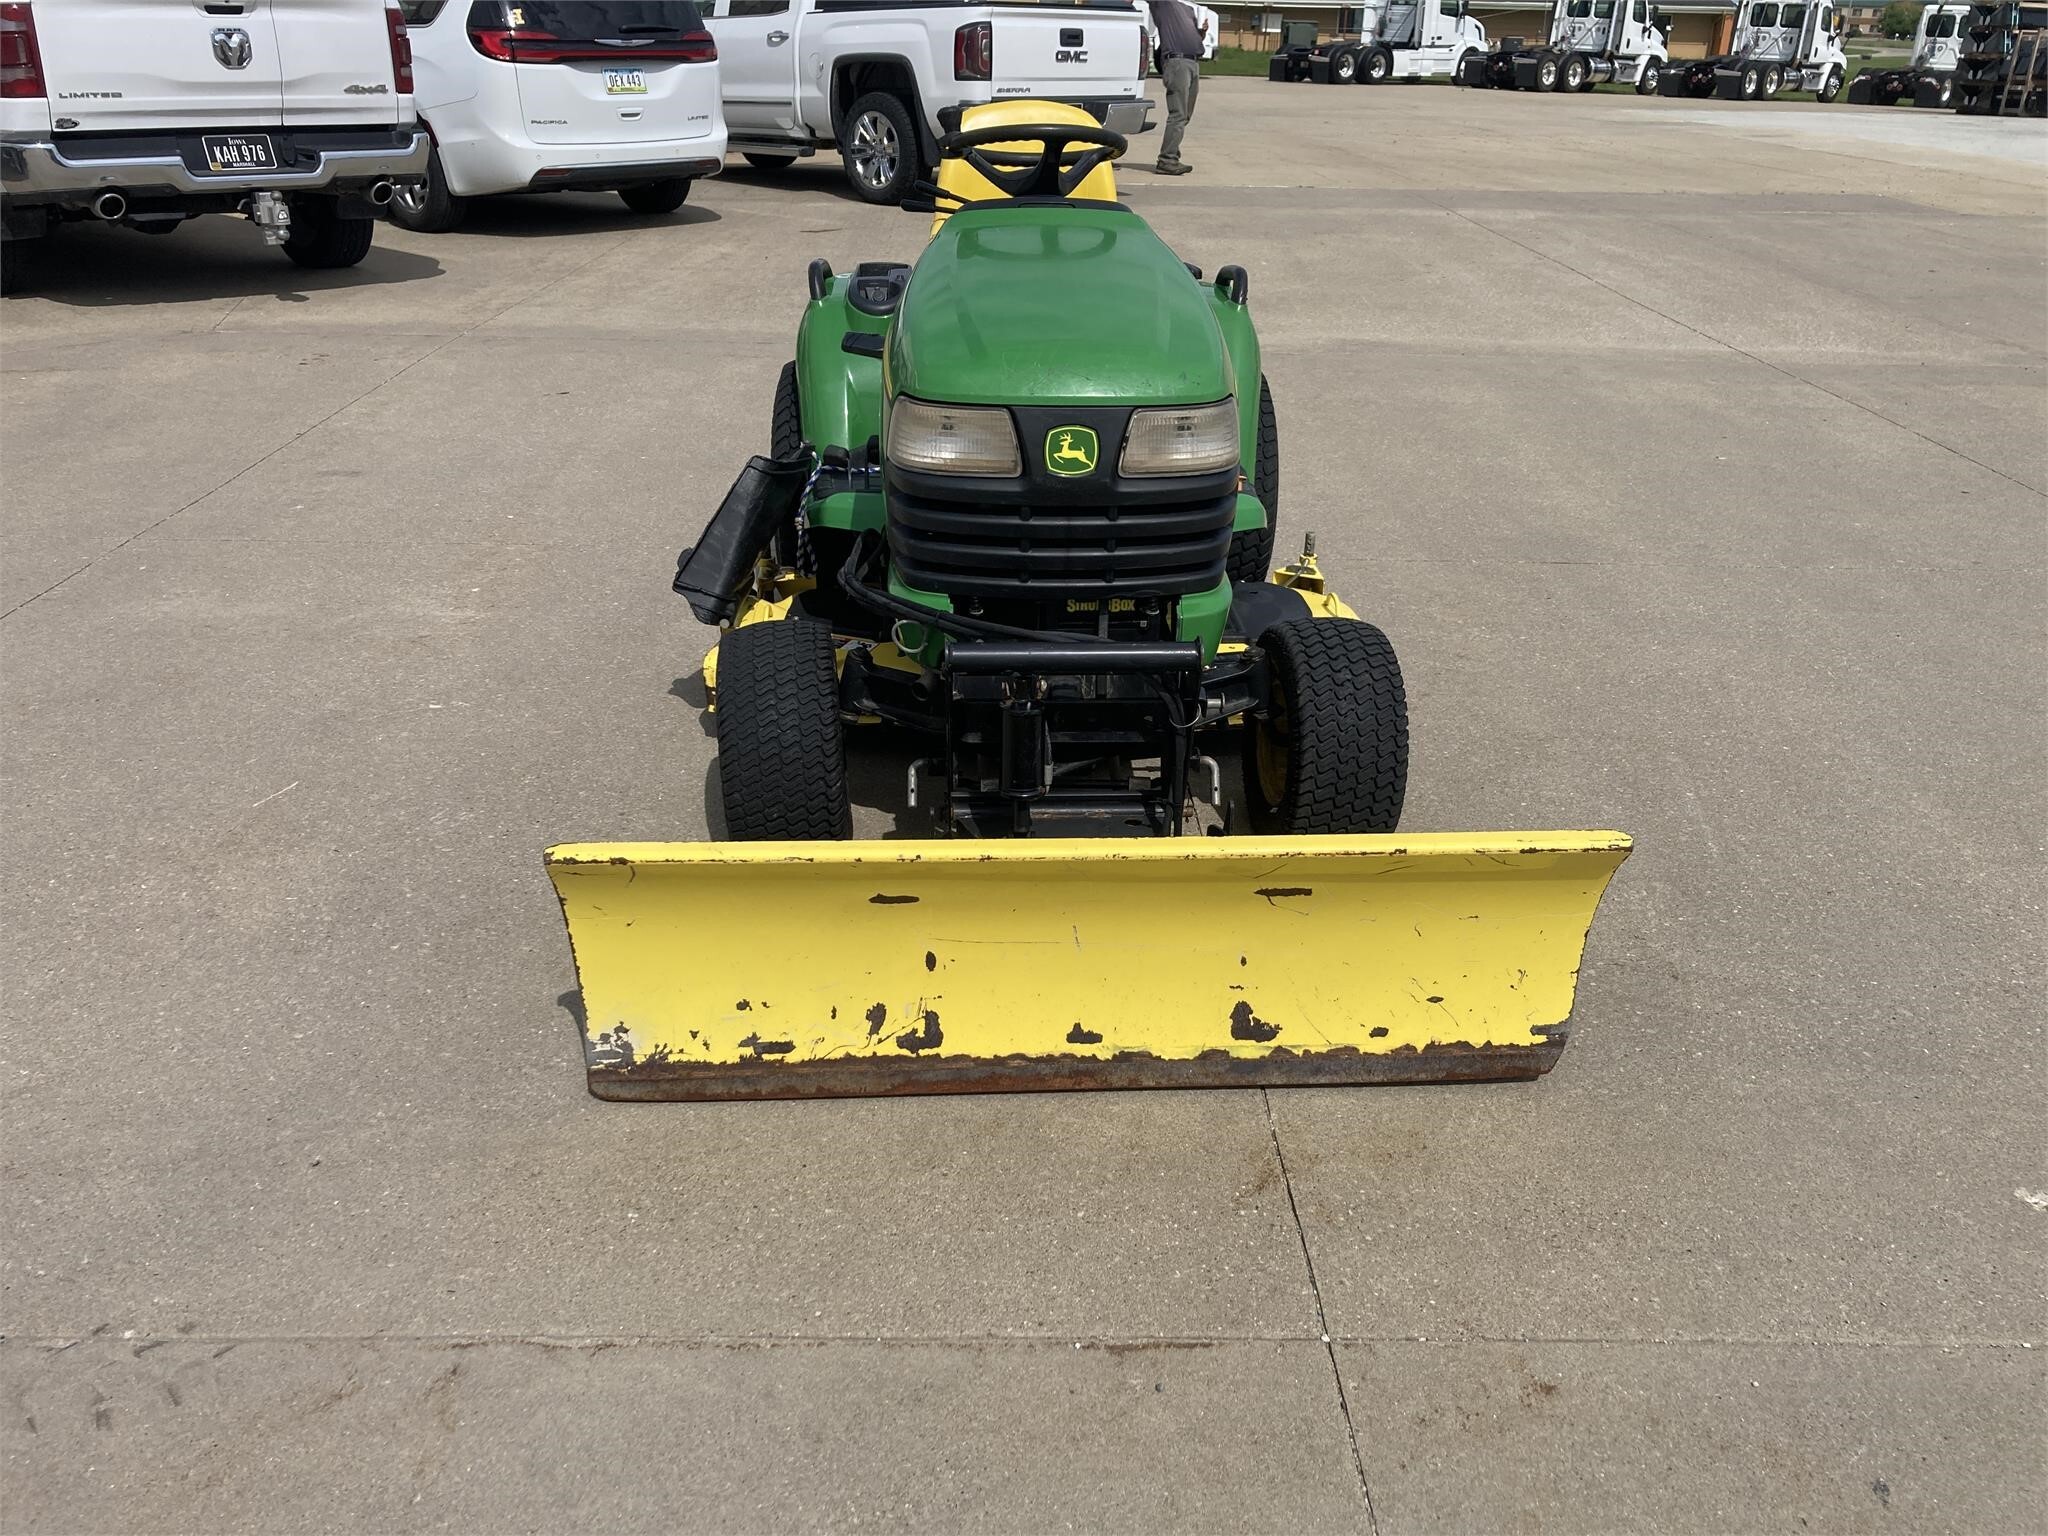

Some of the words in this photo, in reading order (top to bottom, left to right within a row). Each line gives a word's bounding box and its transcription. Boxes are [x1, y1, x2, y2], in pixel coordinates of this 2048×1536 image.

[1055, 50, 1088, 63] GMC
[626, 74, 642, 87] 443
[213, 145, 241, 163] KAH
[241, 144, 266, 162] 976
